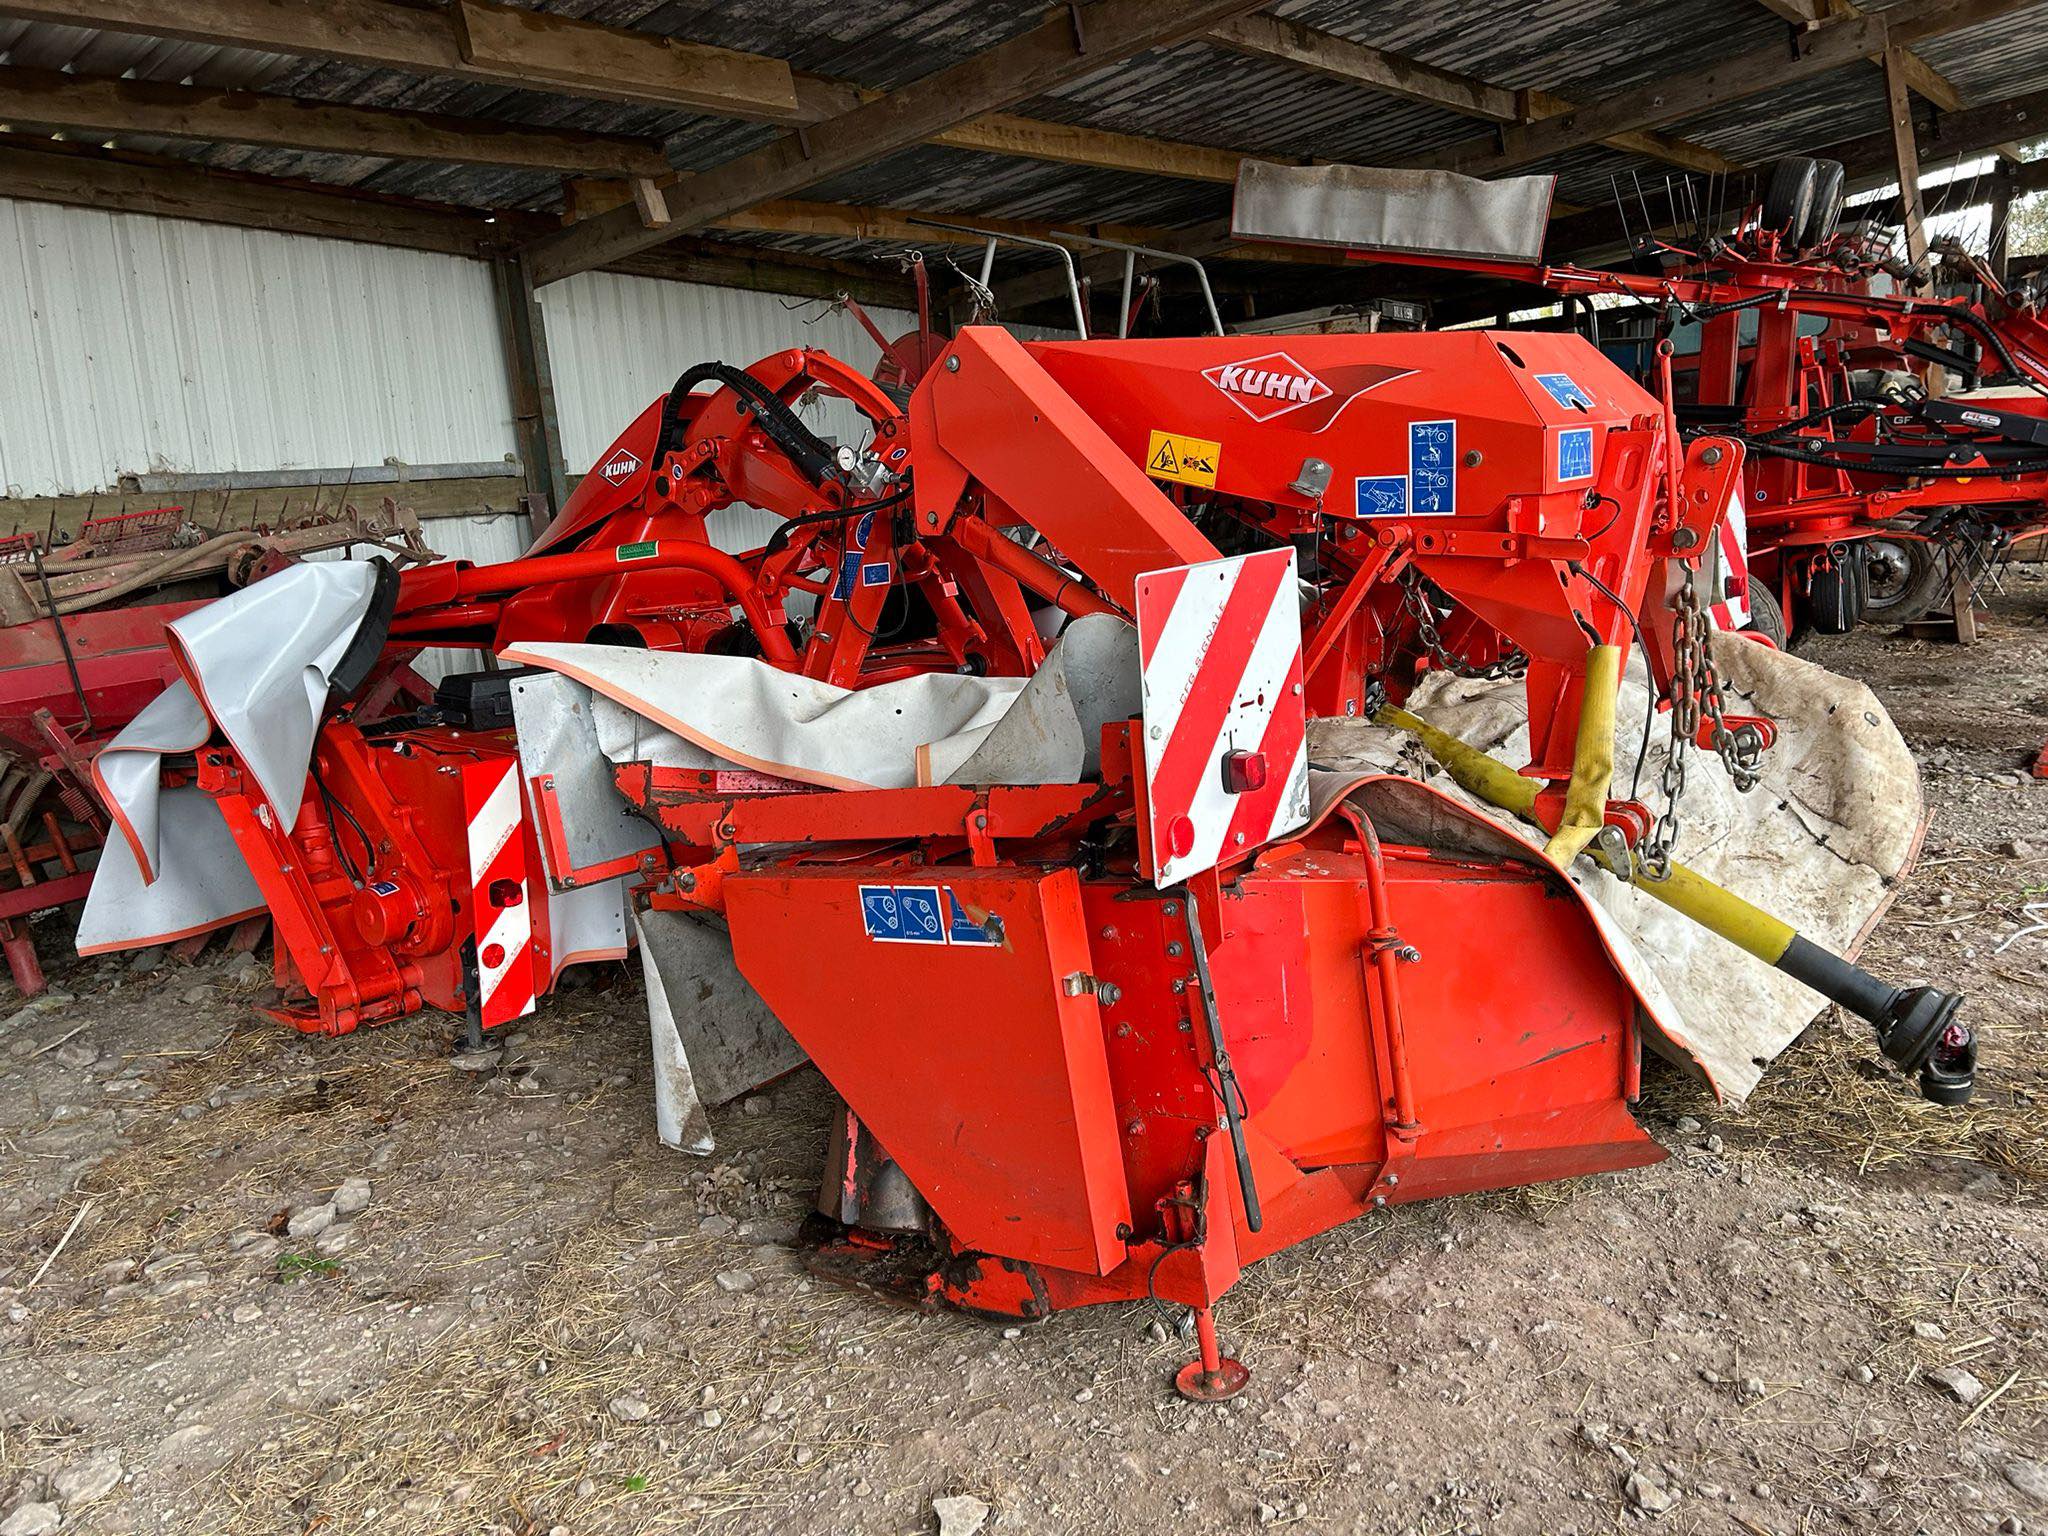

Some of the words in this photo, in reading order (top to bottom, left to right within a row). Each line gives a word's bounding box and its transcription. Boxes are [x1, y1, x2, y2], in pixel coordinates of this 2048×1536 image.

[1218, 365, 1317, 403] KUHN
[1893, 415, 1913, 425] GF
[605, 460, 636, 477] KUHN
